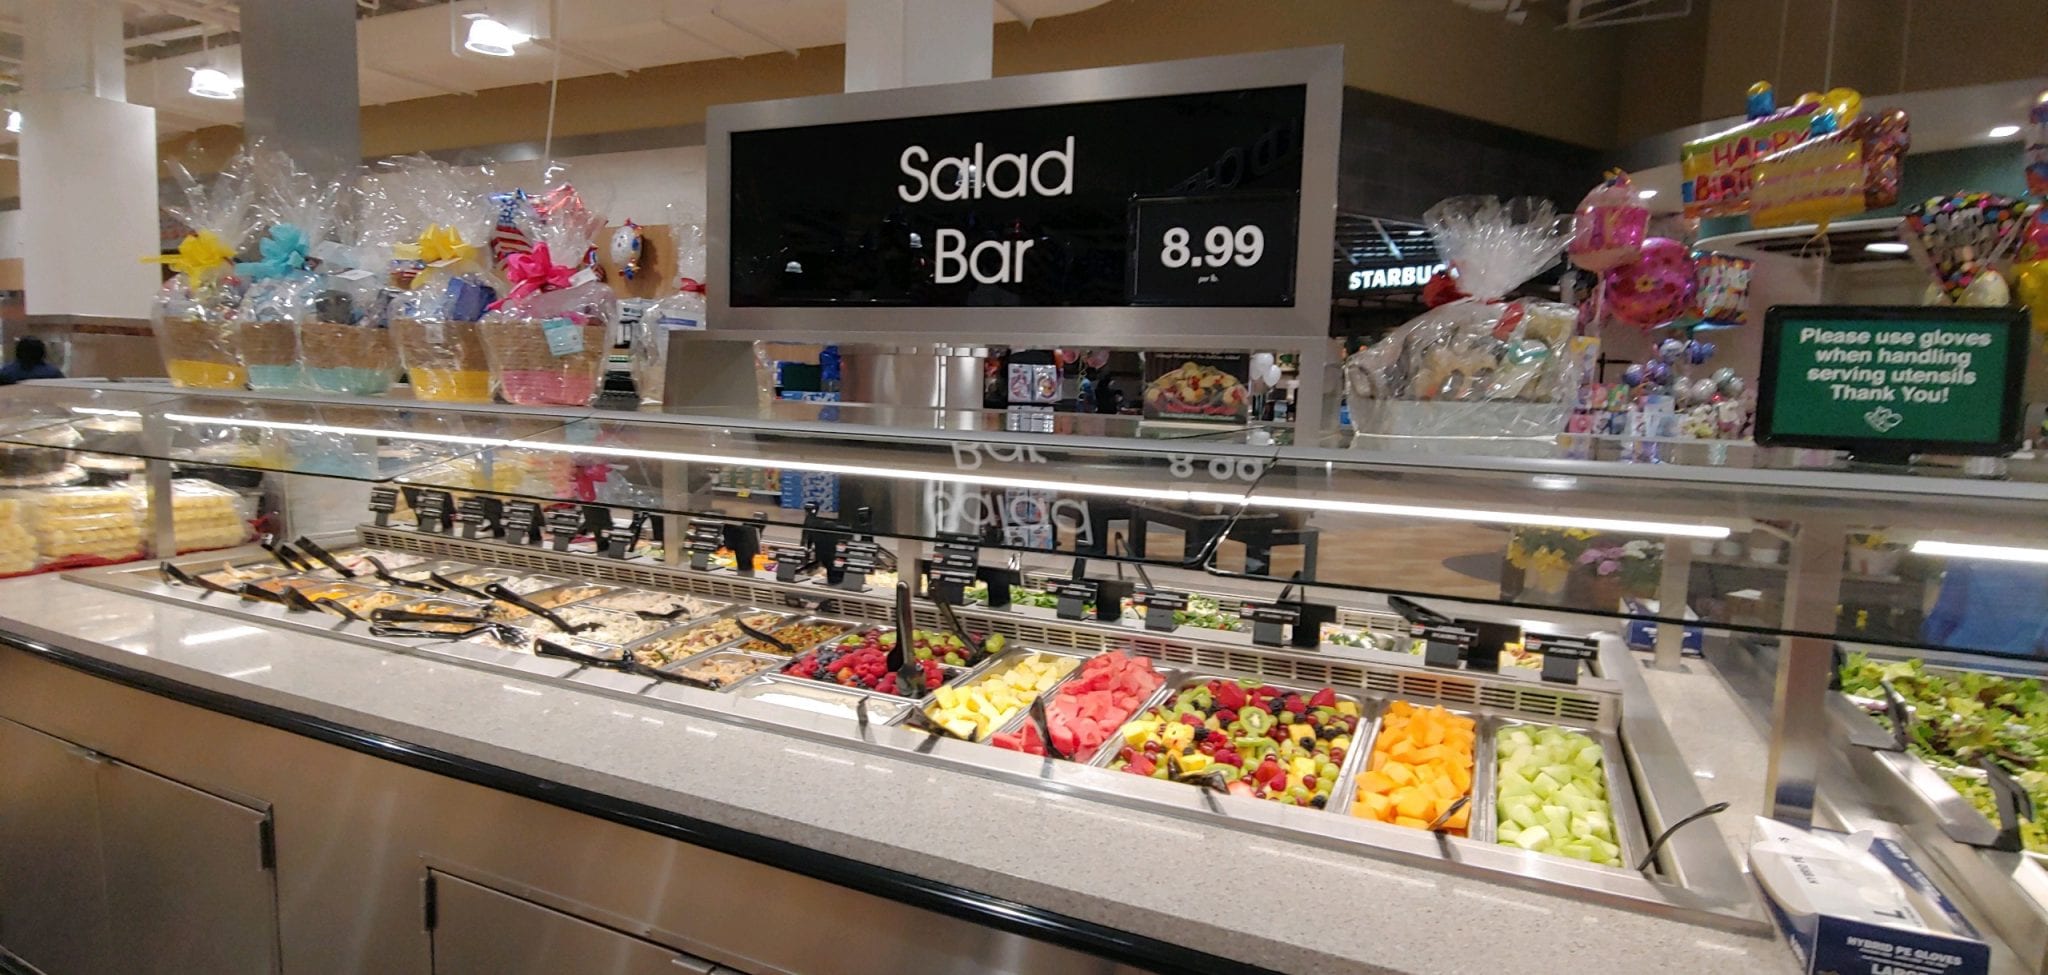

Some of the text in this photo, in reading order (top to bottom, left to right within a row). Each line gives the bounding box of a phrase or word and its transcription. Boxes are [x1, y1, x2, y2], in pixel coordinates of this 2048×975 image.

[898, 135, 1075, 203] Salad
[934, 228, 1034, 284] Bar
[1161, 225, 1264, 268] 8.99
[1799, 327, 1992, 350] Please use gloves
[1815, 347, 1972, 368] when handling
[1807, 366, 1977, 386] serving utensils
[1829, 383, 1950, 403] Thank You!
[1846, 936, 1894, 953] HYBRID
[1894, 945, 1913, 957] PE
[1913, 949, 1963, 966] GLOVES
